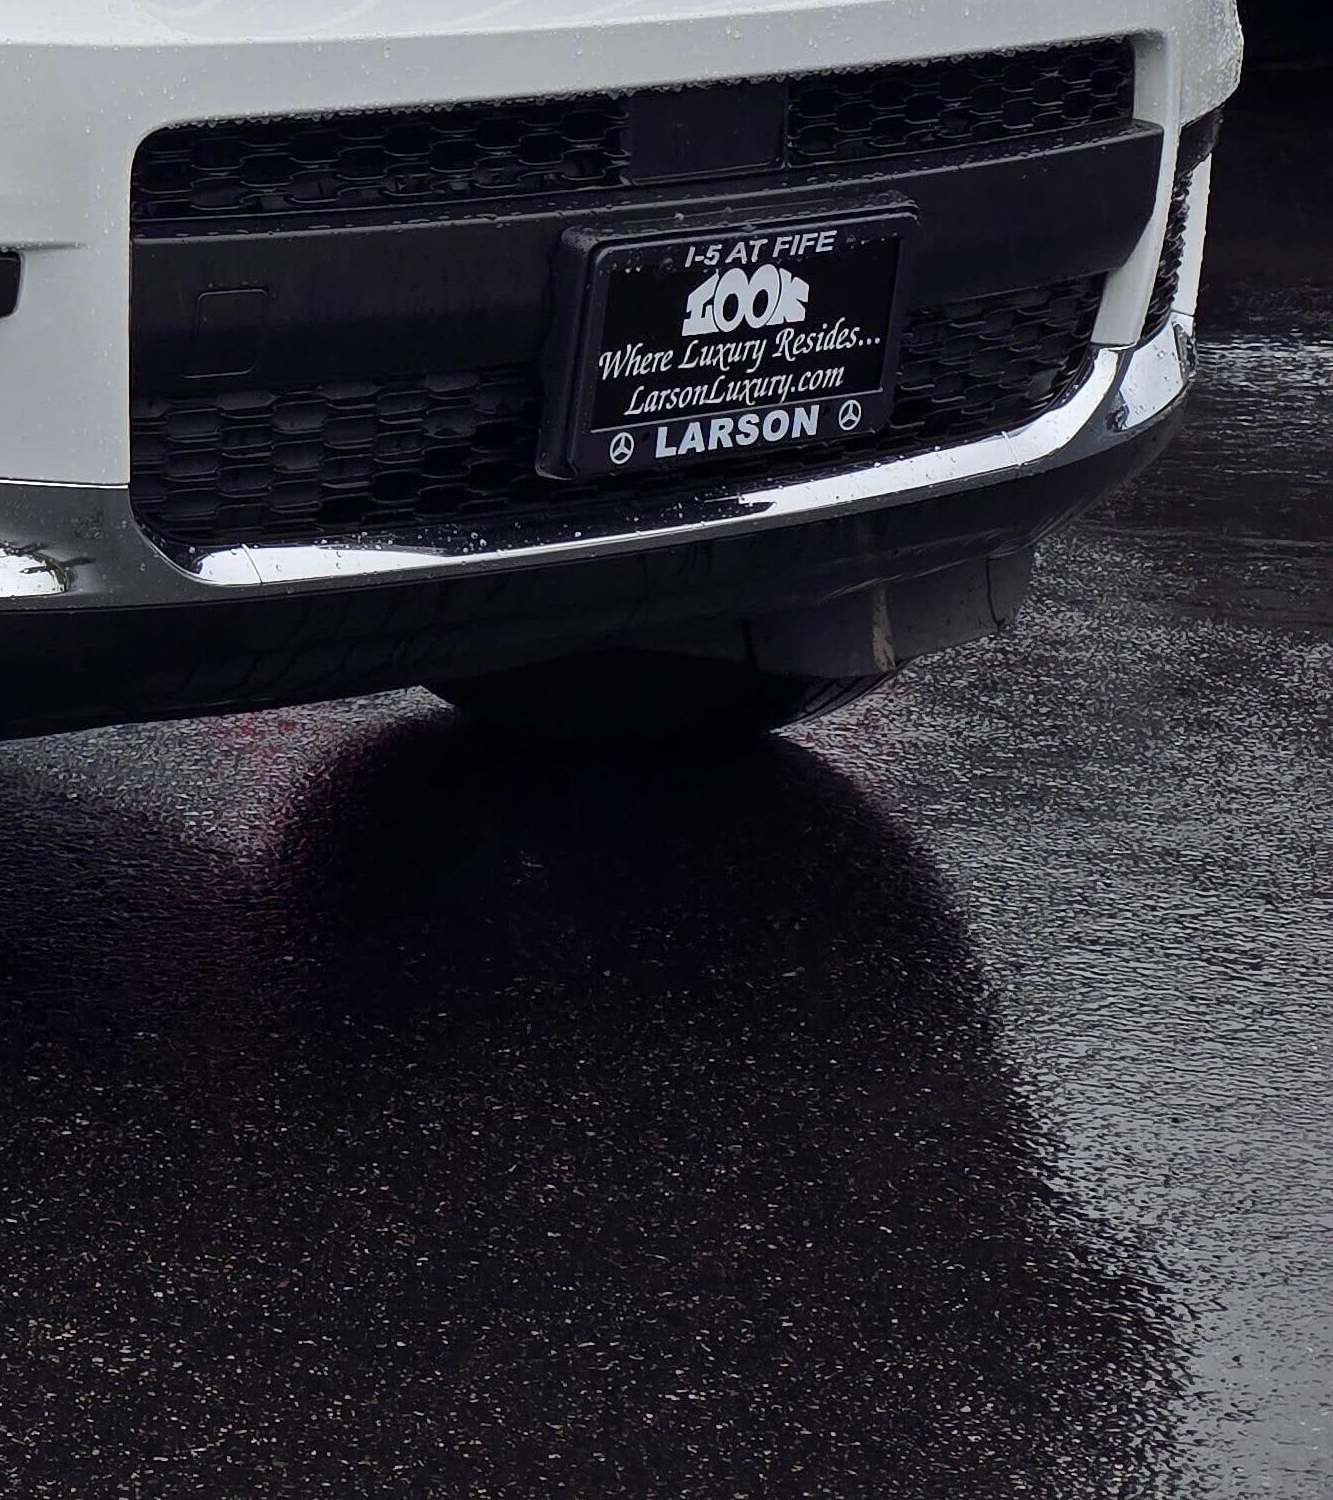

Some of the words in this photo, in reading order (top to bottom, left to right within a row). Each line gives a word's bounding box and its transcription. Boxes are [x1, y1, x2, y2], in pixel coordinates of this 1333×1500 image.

[684, 245, 722, 269] I-5
[726, 239, 766, 264] AT
[772, 230, 838, 259] FIFE
[598, 343, 673, 381] Where
[677, 338, 767, 372] Luxury
[772, 317, 881, 361] Resides...
[623, 363, 845, 416] LarsonLuxury.com
[654, 404, 820, 459] LARSON
